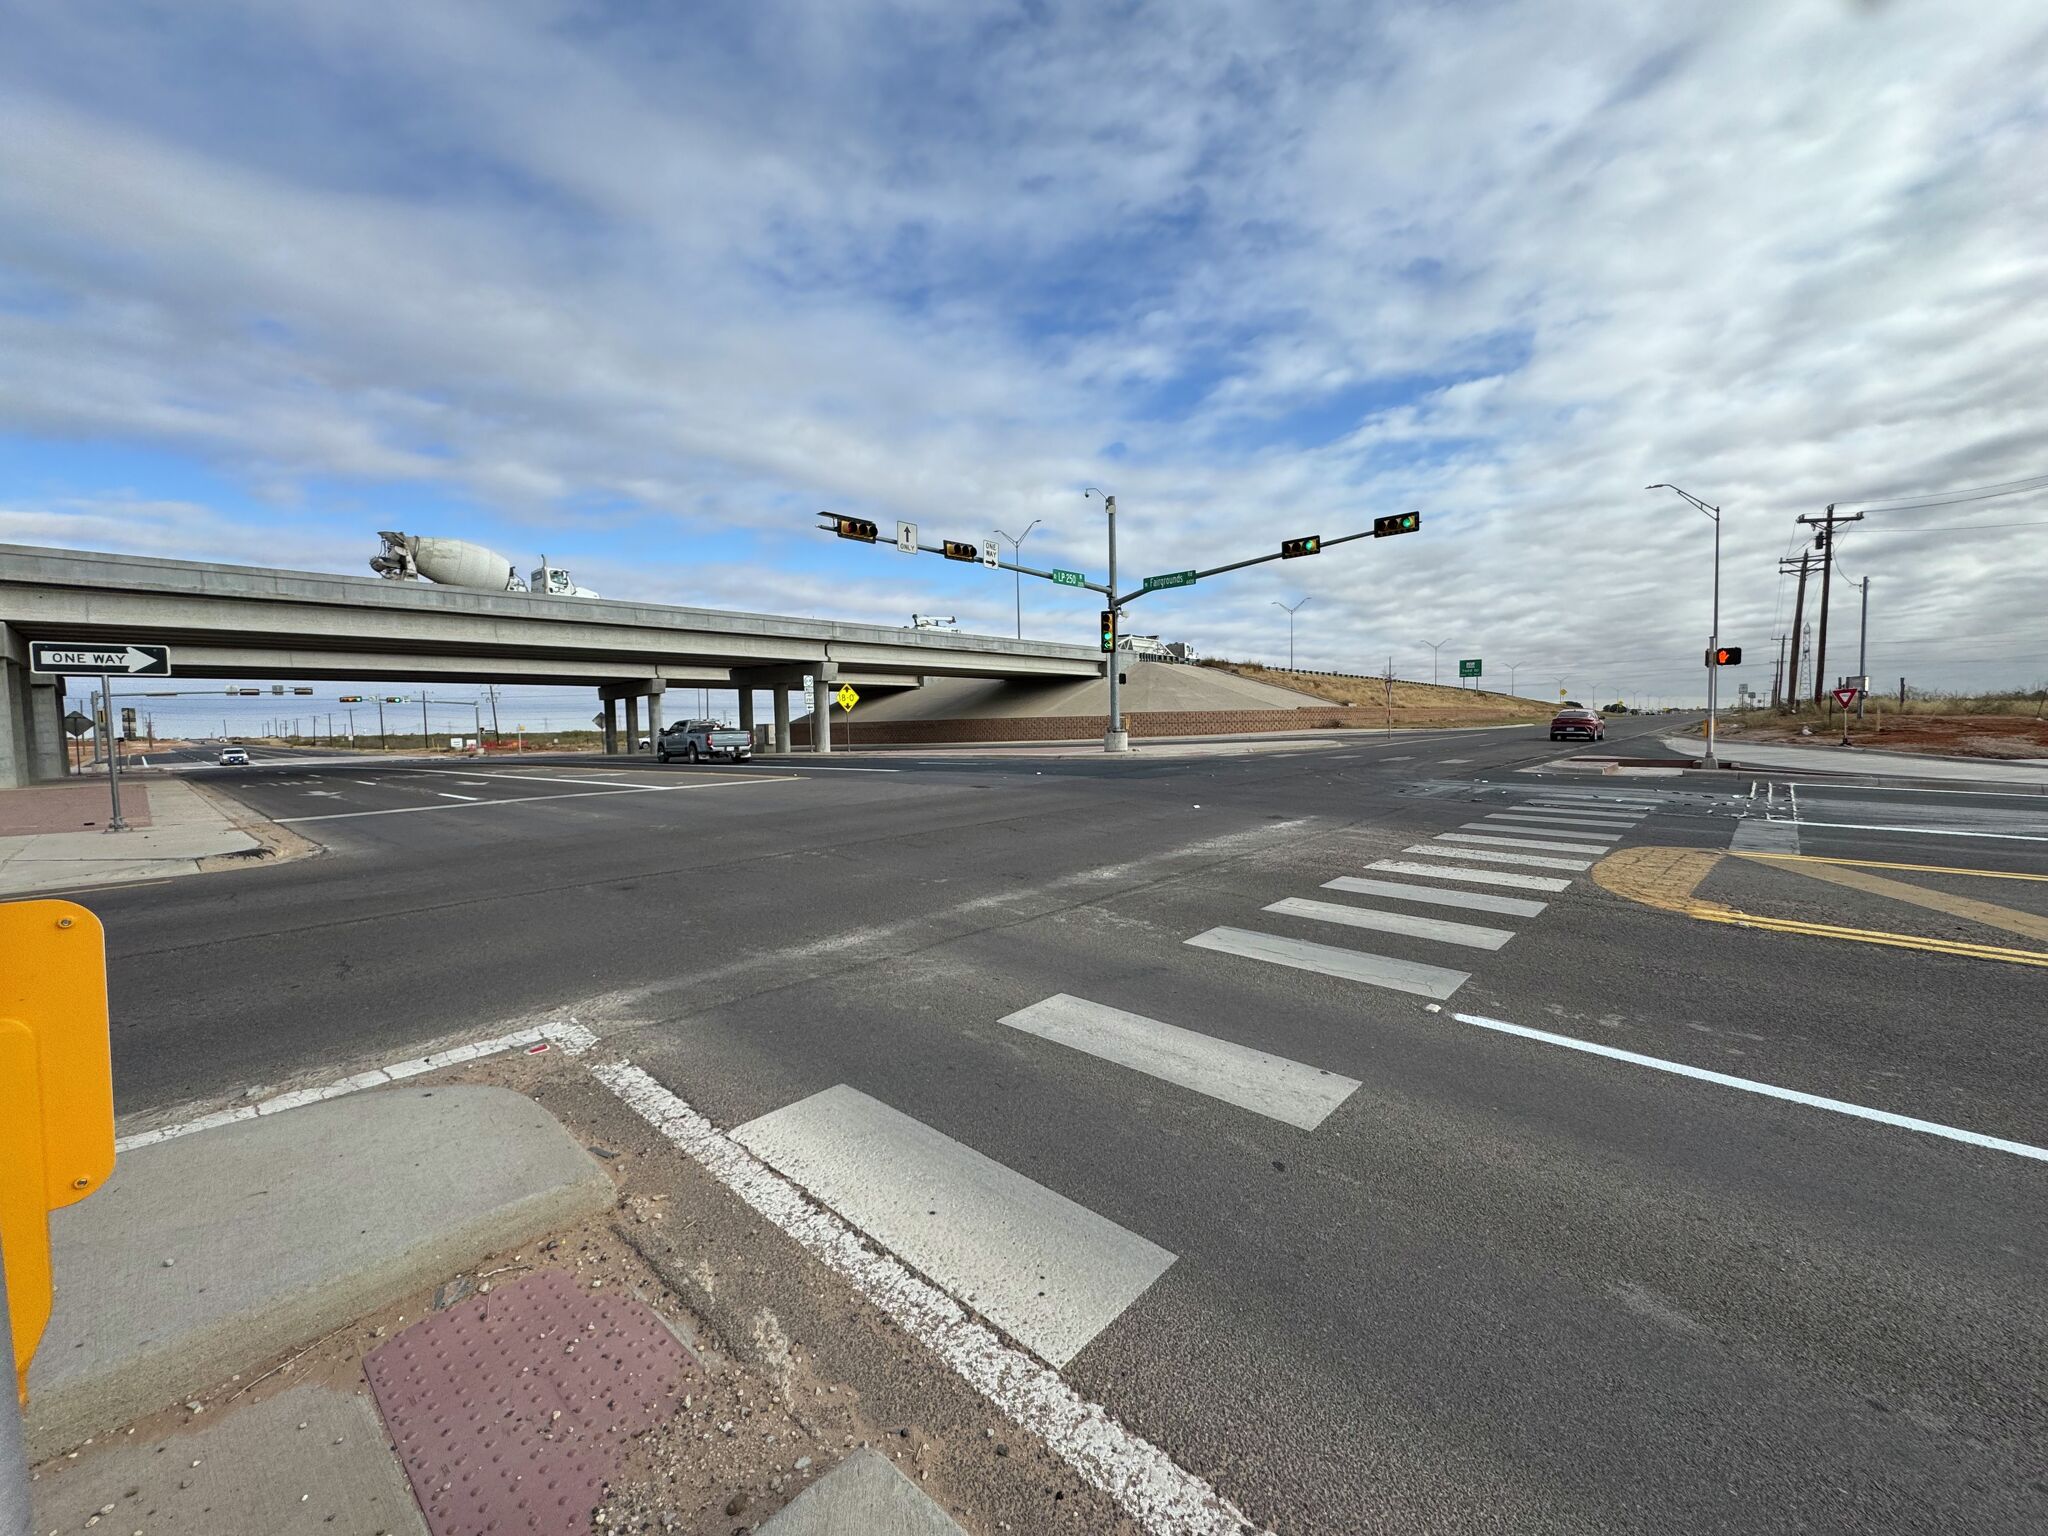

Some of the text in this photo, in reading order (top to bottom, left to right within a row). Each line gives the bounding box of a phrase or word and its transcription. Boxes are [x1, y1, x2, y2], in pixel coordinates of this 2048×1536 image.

[900, 543, 915, 551] ONLY
[986, 550, 997, 558] WAY
[1057, 572, 1065, 582] LP
[1066, 573, 1077, 584] 250
[1150, 574, 1183, 588] Fairgrounds
[52, 653, 126, 664] ONE WAY
